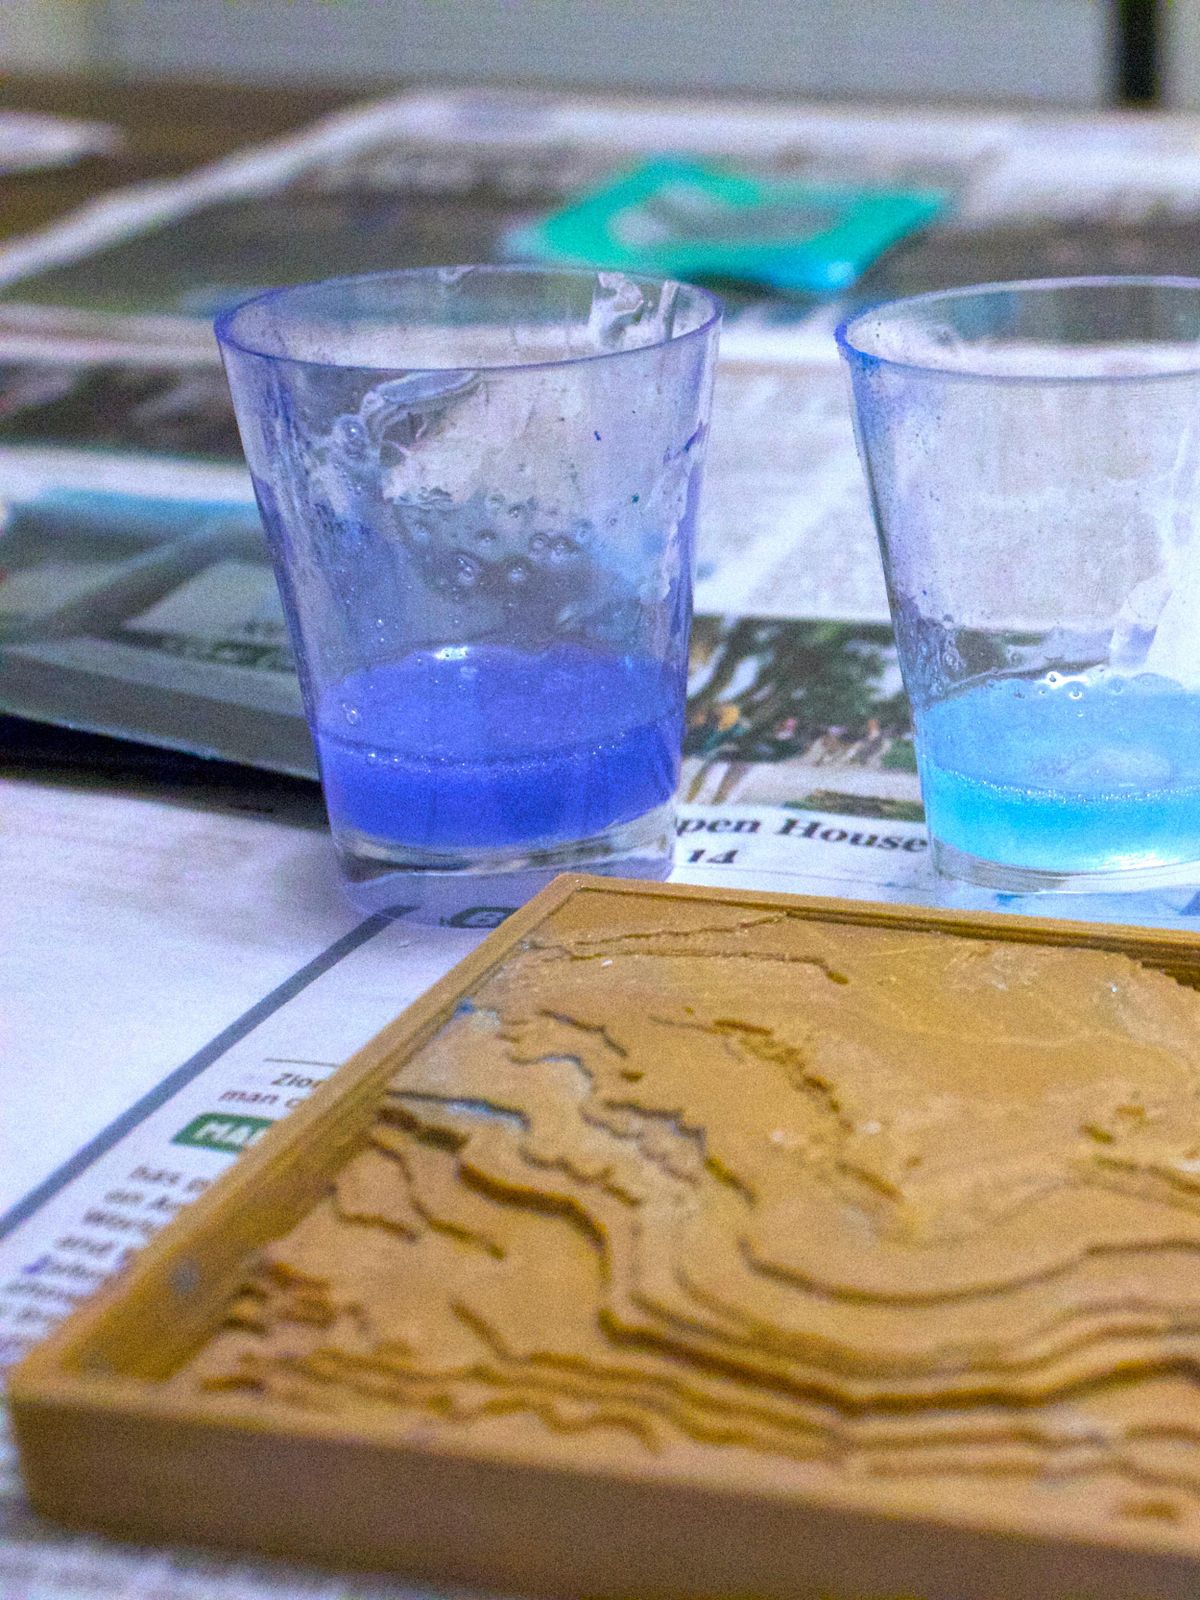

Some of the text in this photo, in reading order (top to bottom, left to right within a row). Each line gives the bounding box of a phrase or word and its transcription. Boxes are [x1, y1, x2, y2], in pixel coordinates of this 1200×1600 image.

[675, 817, 929, 852] pen House
[219, 1090, 280, 1104] man
